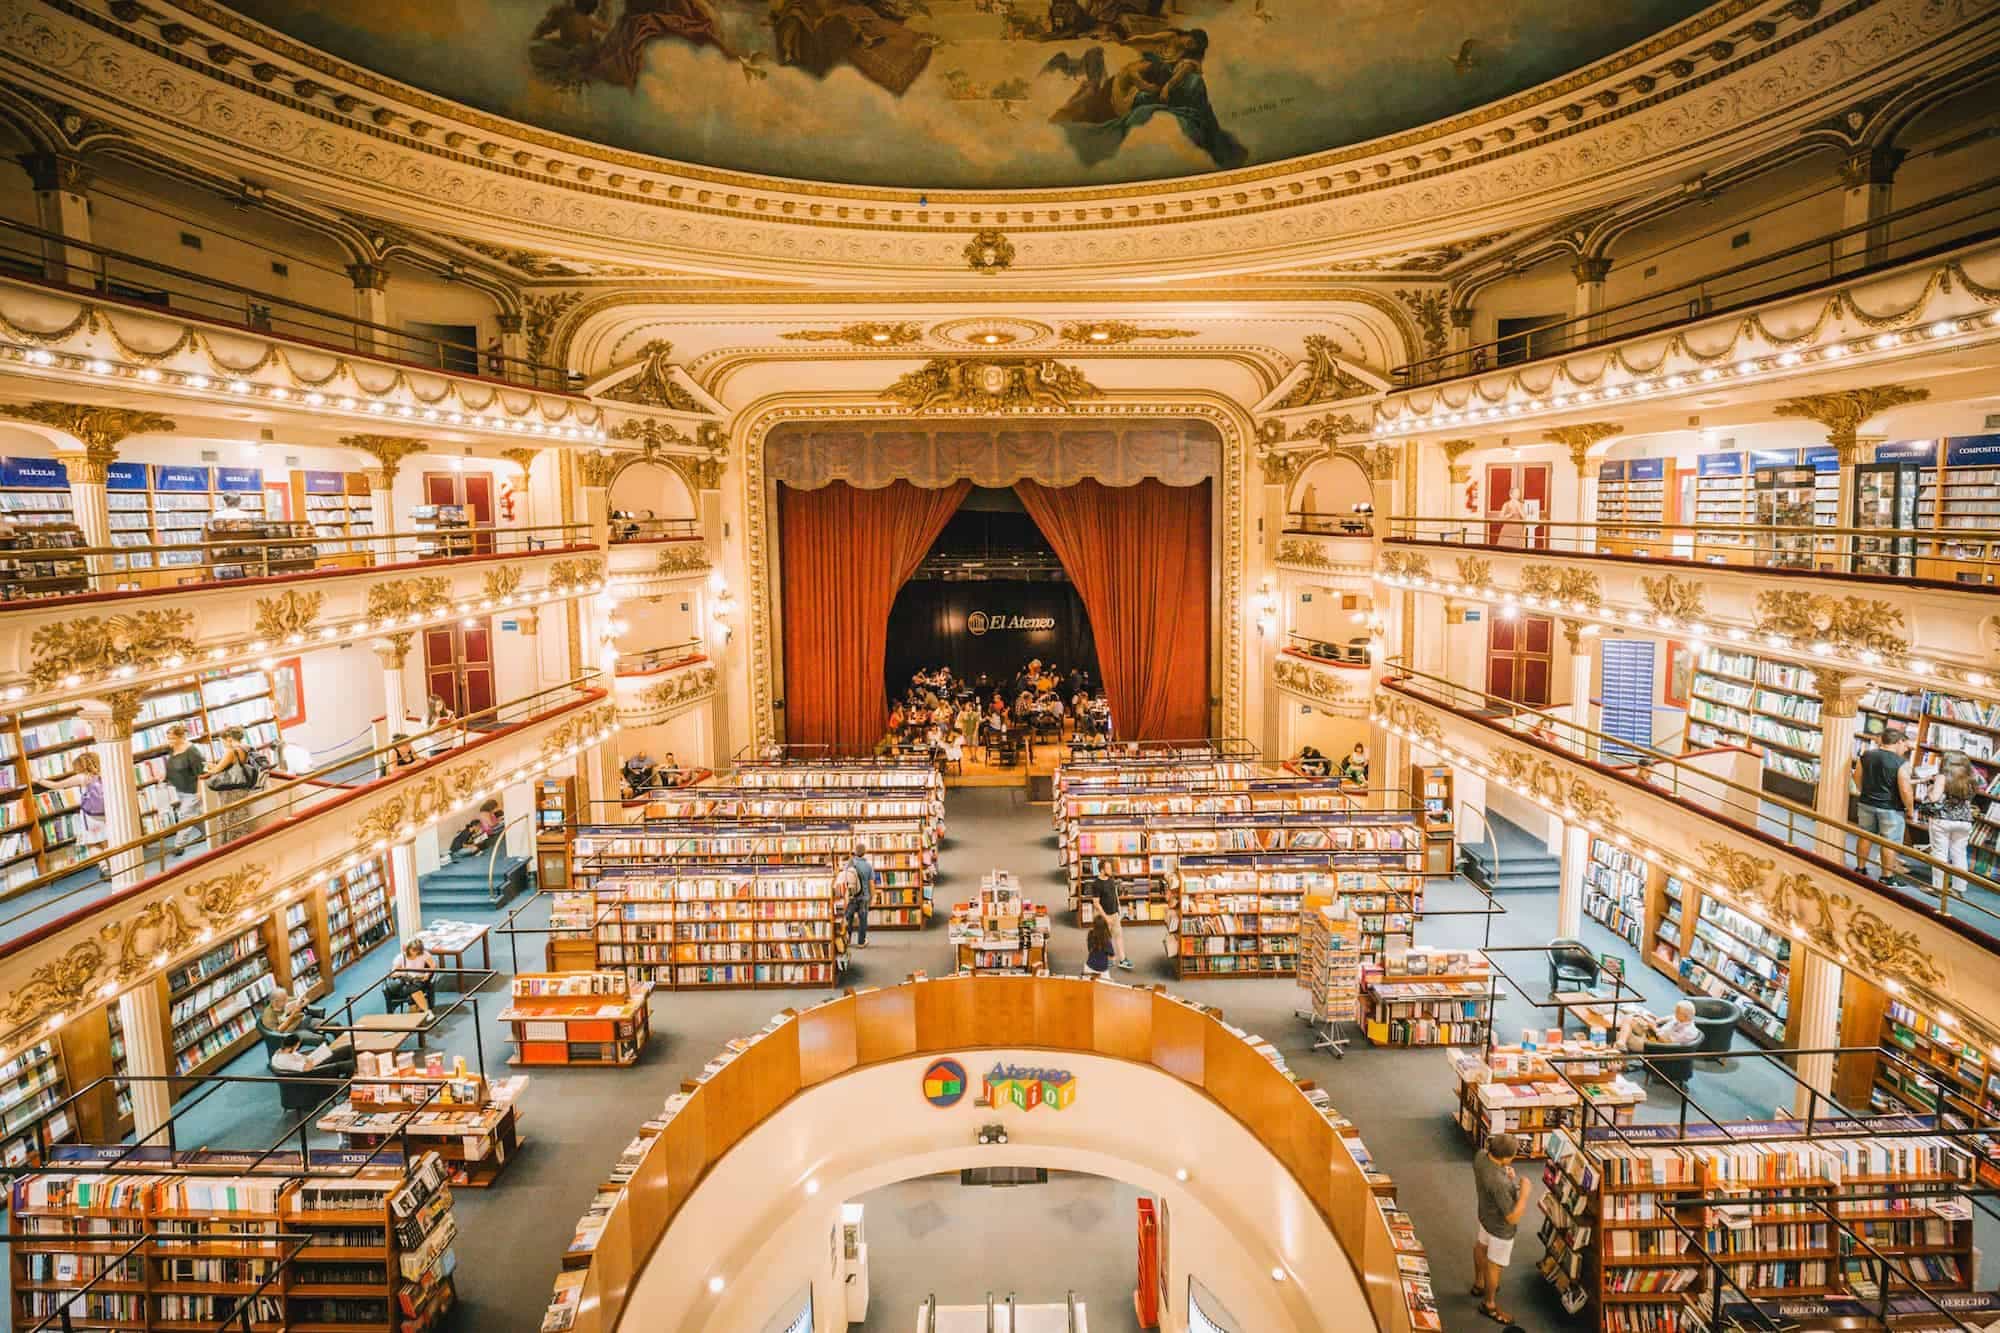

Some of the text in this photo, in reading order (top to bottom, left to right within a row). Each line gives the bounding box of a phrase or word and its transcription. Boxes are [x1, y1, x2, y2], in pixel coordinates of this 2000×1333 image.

[989, 615, 1055, 630] El Ateneo
[986, 1061, 1072, 1082] Ateneo
[985, 1081, 1073, 1110] Junior
[1779, 1304, 1829, 1315] DERECHO
[1940, 1297, 1990, 1307] DERECHO
